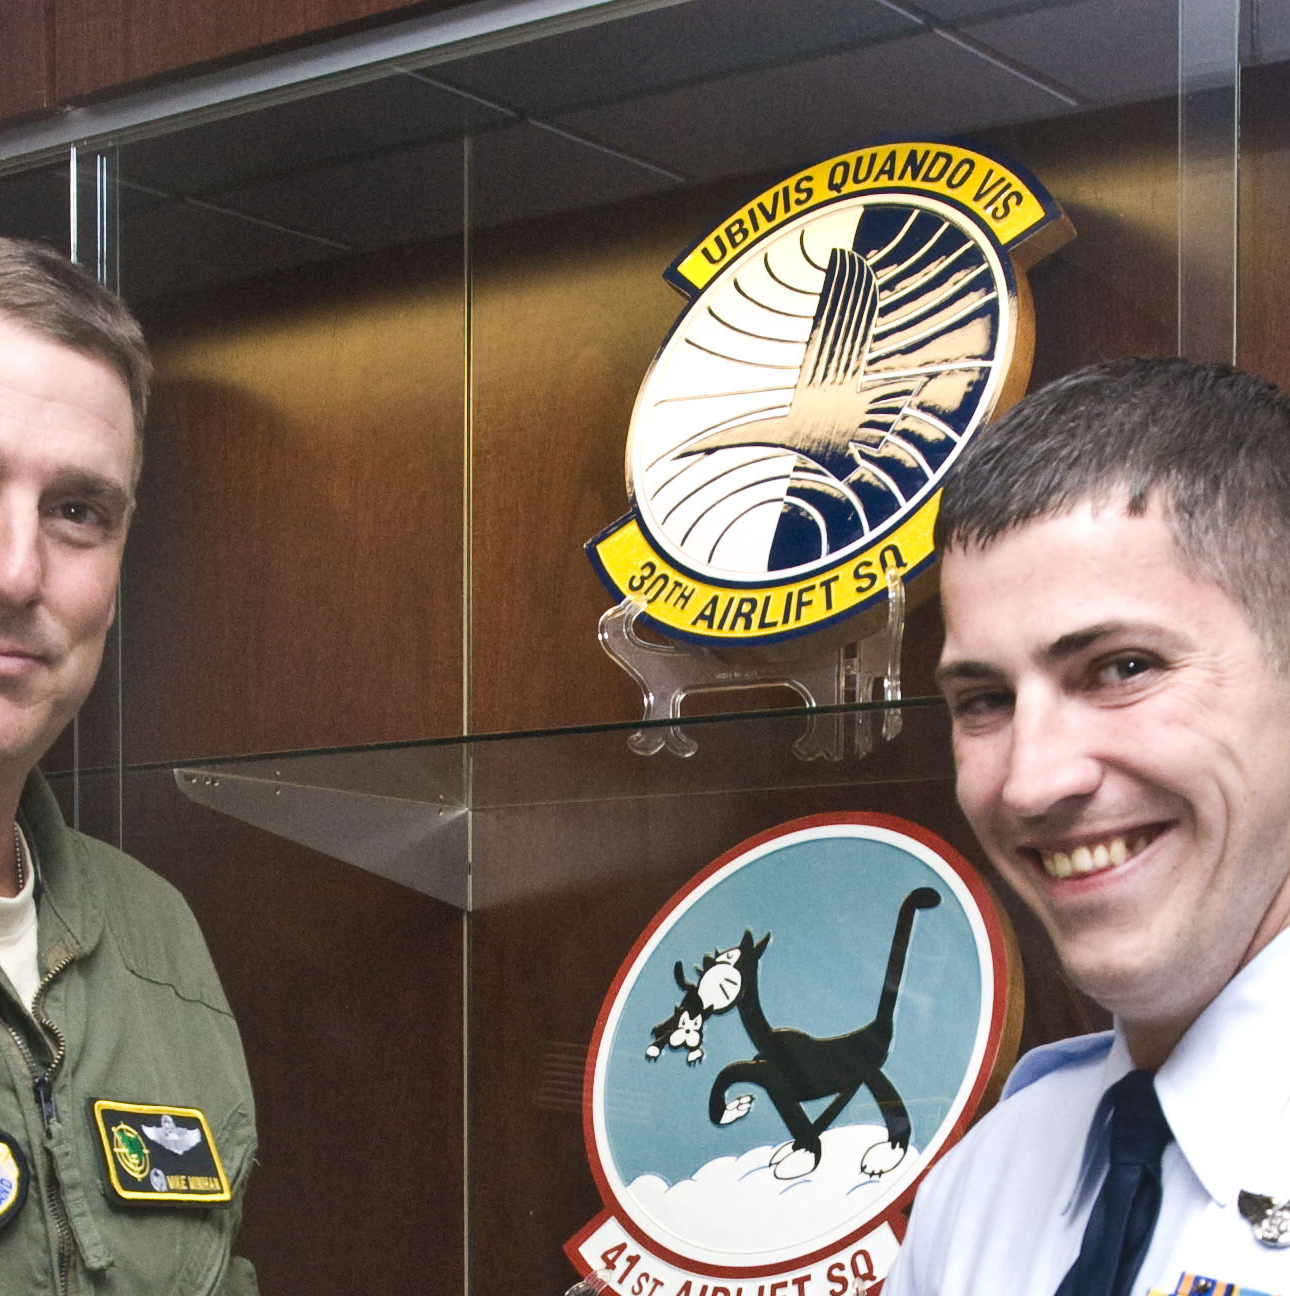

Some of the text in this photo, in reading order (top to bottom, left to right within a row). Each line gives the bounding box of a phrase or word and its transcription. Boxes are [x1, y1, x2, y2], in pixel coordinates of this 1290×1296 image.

[701, 149, 1025, 266] UBIVIS QUANDO VIS
[628, 544, 908, 632] 30TH AIRLIFT SQ
